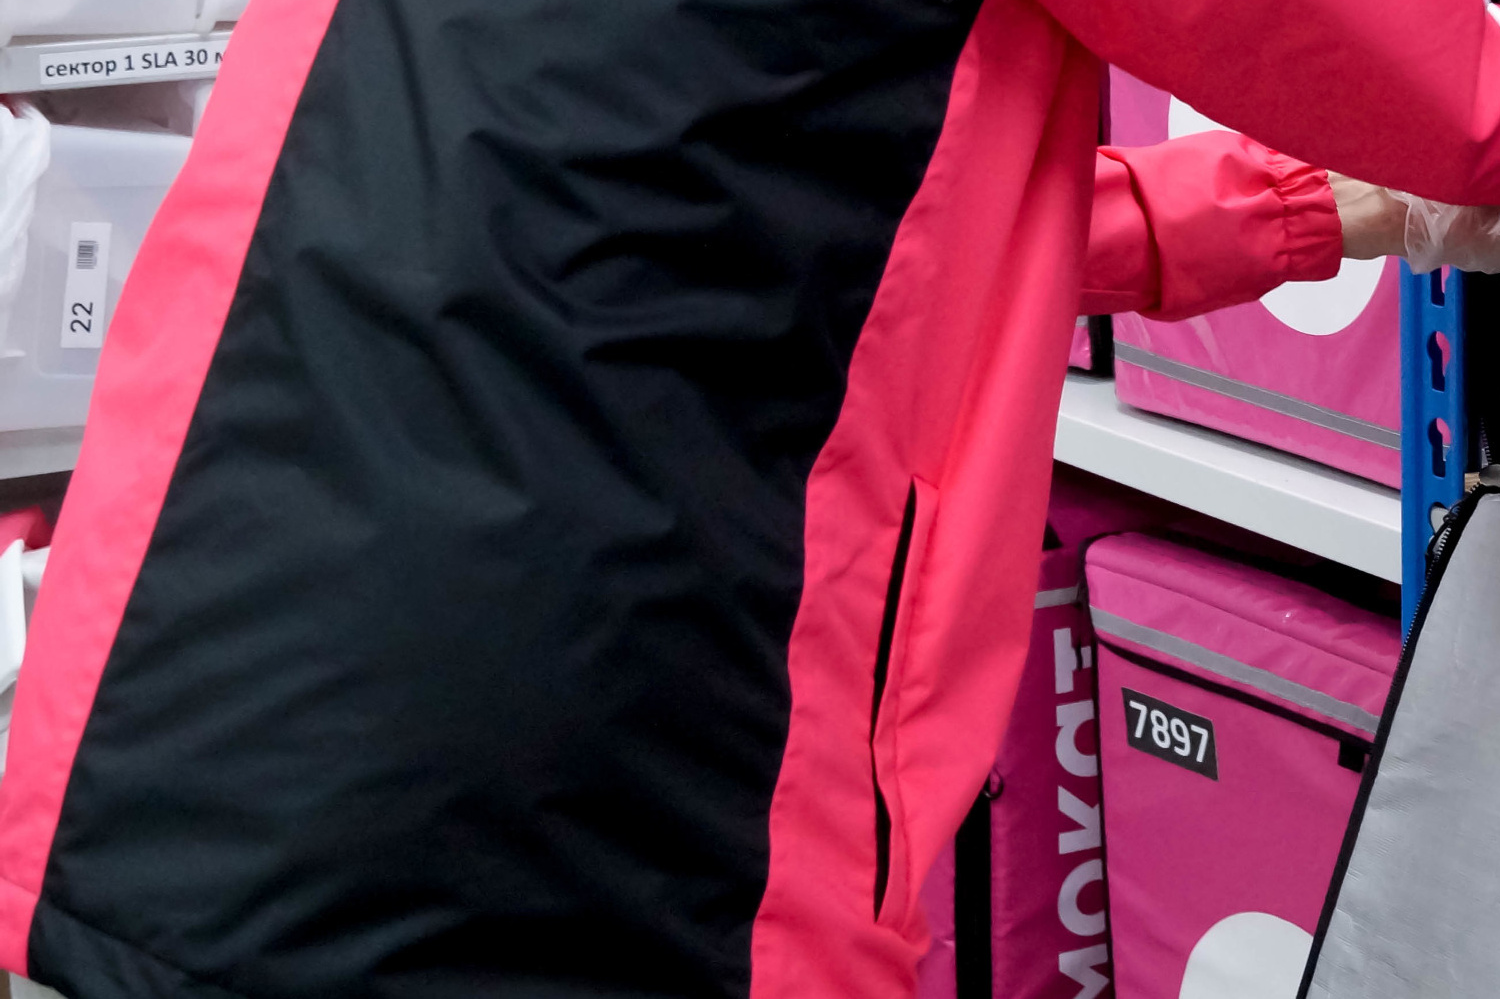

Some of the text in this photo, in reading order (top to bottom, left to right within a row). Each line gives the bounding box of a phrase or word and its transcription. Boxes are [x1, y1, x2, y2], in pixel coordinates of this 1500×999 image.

[45, 59, 117, 78] сектор
[124, 54, 135, 72] 1
[142, 51, 178, 69] SLA
[184, 48, 208, 66] 30
[70, 302, 93, 333] 22
[1129, 700, 1209, 763] 7897
